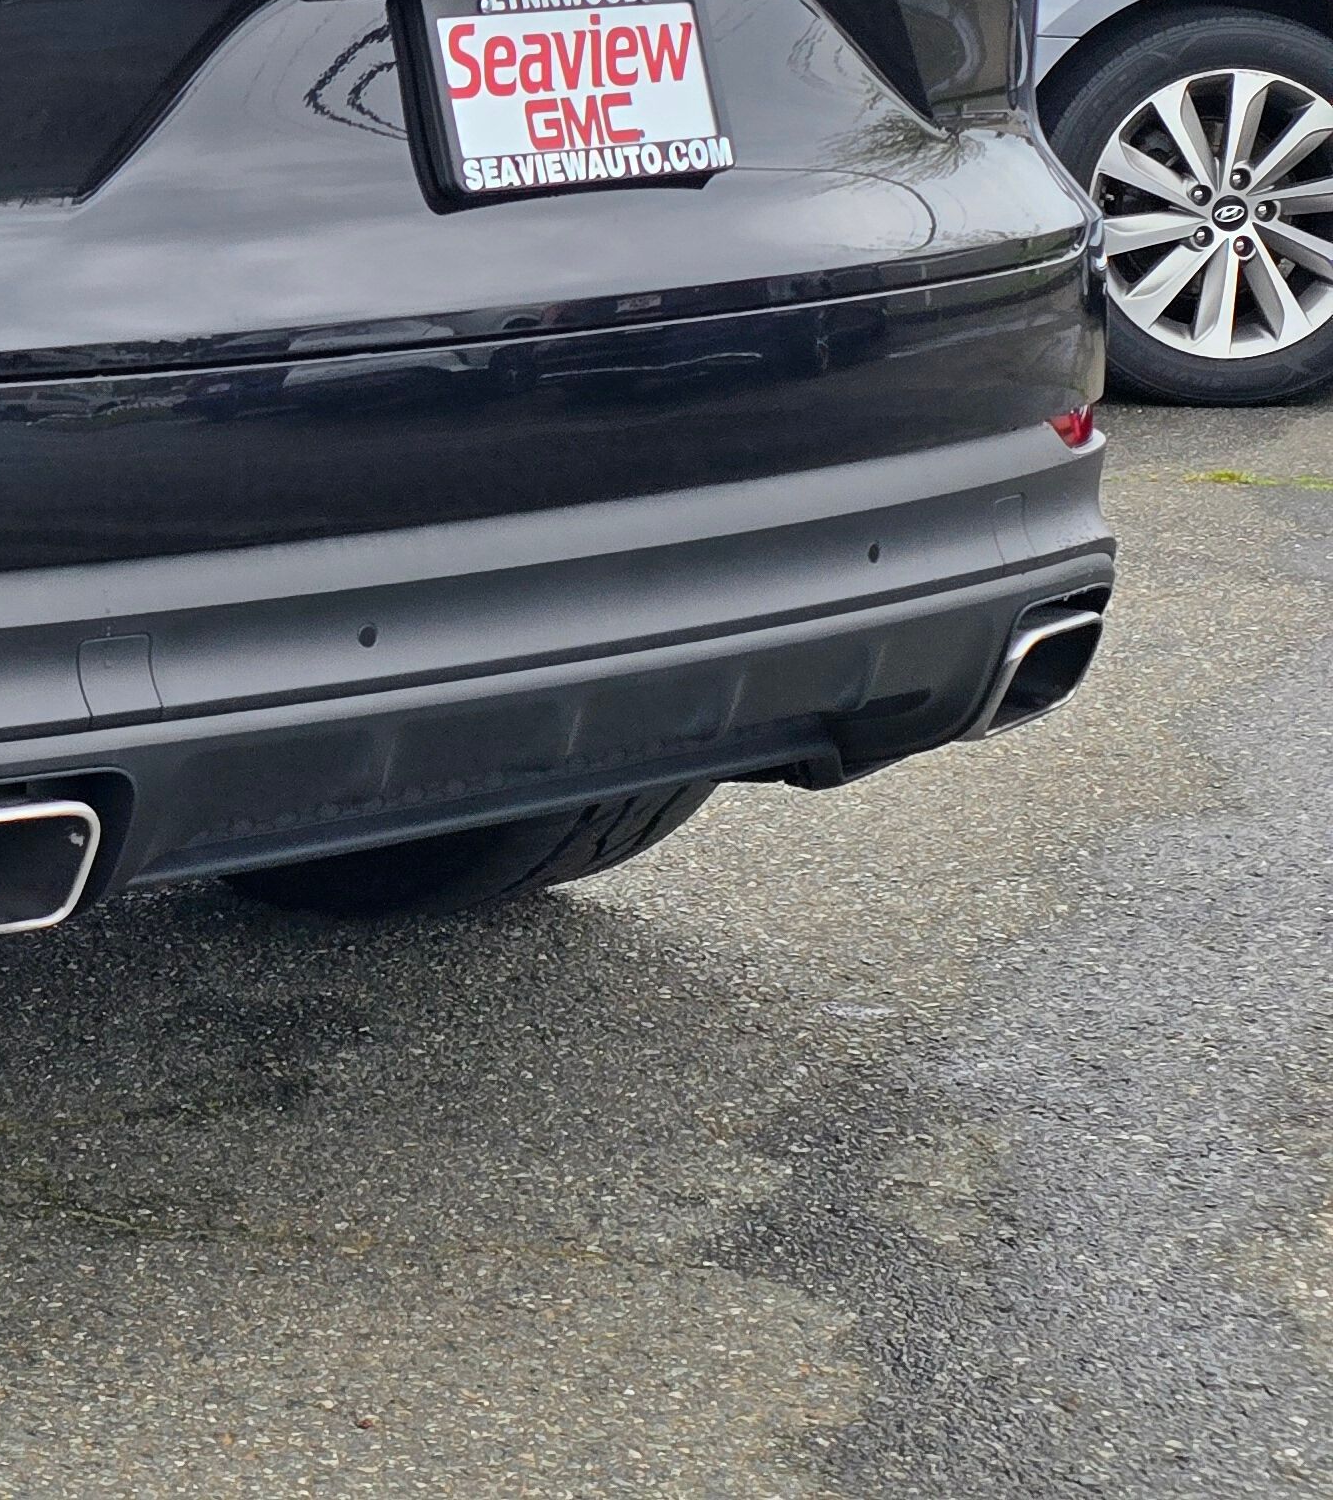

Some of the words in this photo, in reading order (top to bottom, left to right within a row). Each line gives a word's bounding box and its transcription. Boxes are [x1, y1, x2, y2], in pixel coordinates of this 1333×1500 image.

[447, 13, 693, 100] Seaview
[523, 91, 645, 151] GMC
[462, 136, 733, 192] SEAVIEWAUTO.COM
